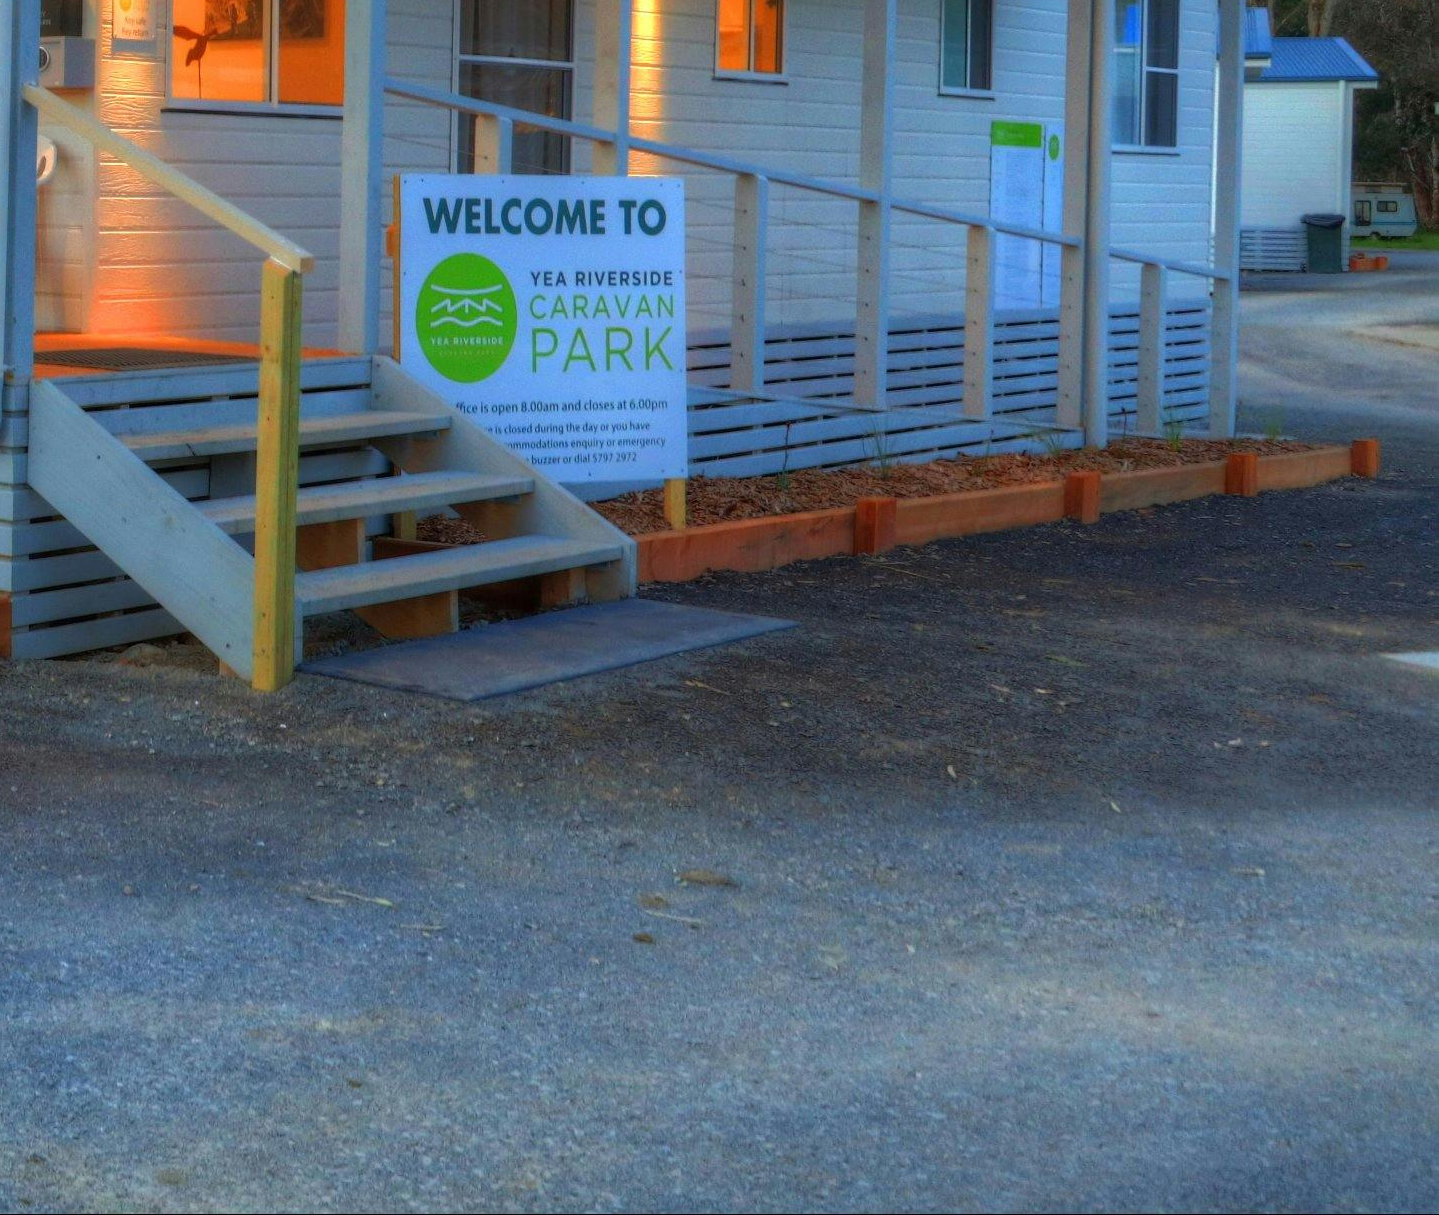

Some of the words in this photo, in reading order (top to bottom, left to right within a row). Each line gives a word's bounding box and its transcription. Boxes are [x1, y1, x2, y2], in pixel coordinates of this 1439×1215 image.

[423, 197, 606, 235] WELCOME
[618, 199, 667, 236] TO
[530, 271, 567, 287] YEA
[575, 271, 673, 286] RIVERSIDE
[529, 294, 674, 319] CARAVAN
[430, 337, 450, 346] YEA
[531, 327, 674, 373] PARK
[480, 401, 489, 414] is
[491, 404, 518, 415] open
[520, 401, 559, 413] 8.00am
[561, 399, 581, 412] and
[583, 399, 615, 411] closes
[616, 400, 627, 411] at
[629, 398, 668, 412] 6.00pm
[495, 423, 502, 434] is
[504, 423, 533, 434] closed
[534, 423, 564, 434] during
[566, 422, 581, 432] the
[582, 422, 598, 434] day
[600, 423, 609, 432] or
[611, 423, 628, 434] you
[629, 420, 650, 431] have
[570, 437, 604, 450] enquiry
[606, 438, 615, 447] or
[617, 436, 666, 449] emergency
[531, 454, 562, 465] buzzer
[562, 454, 572, 464] or
[574, 453, 590, 464] dial
